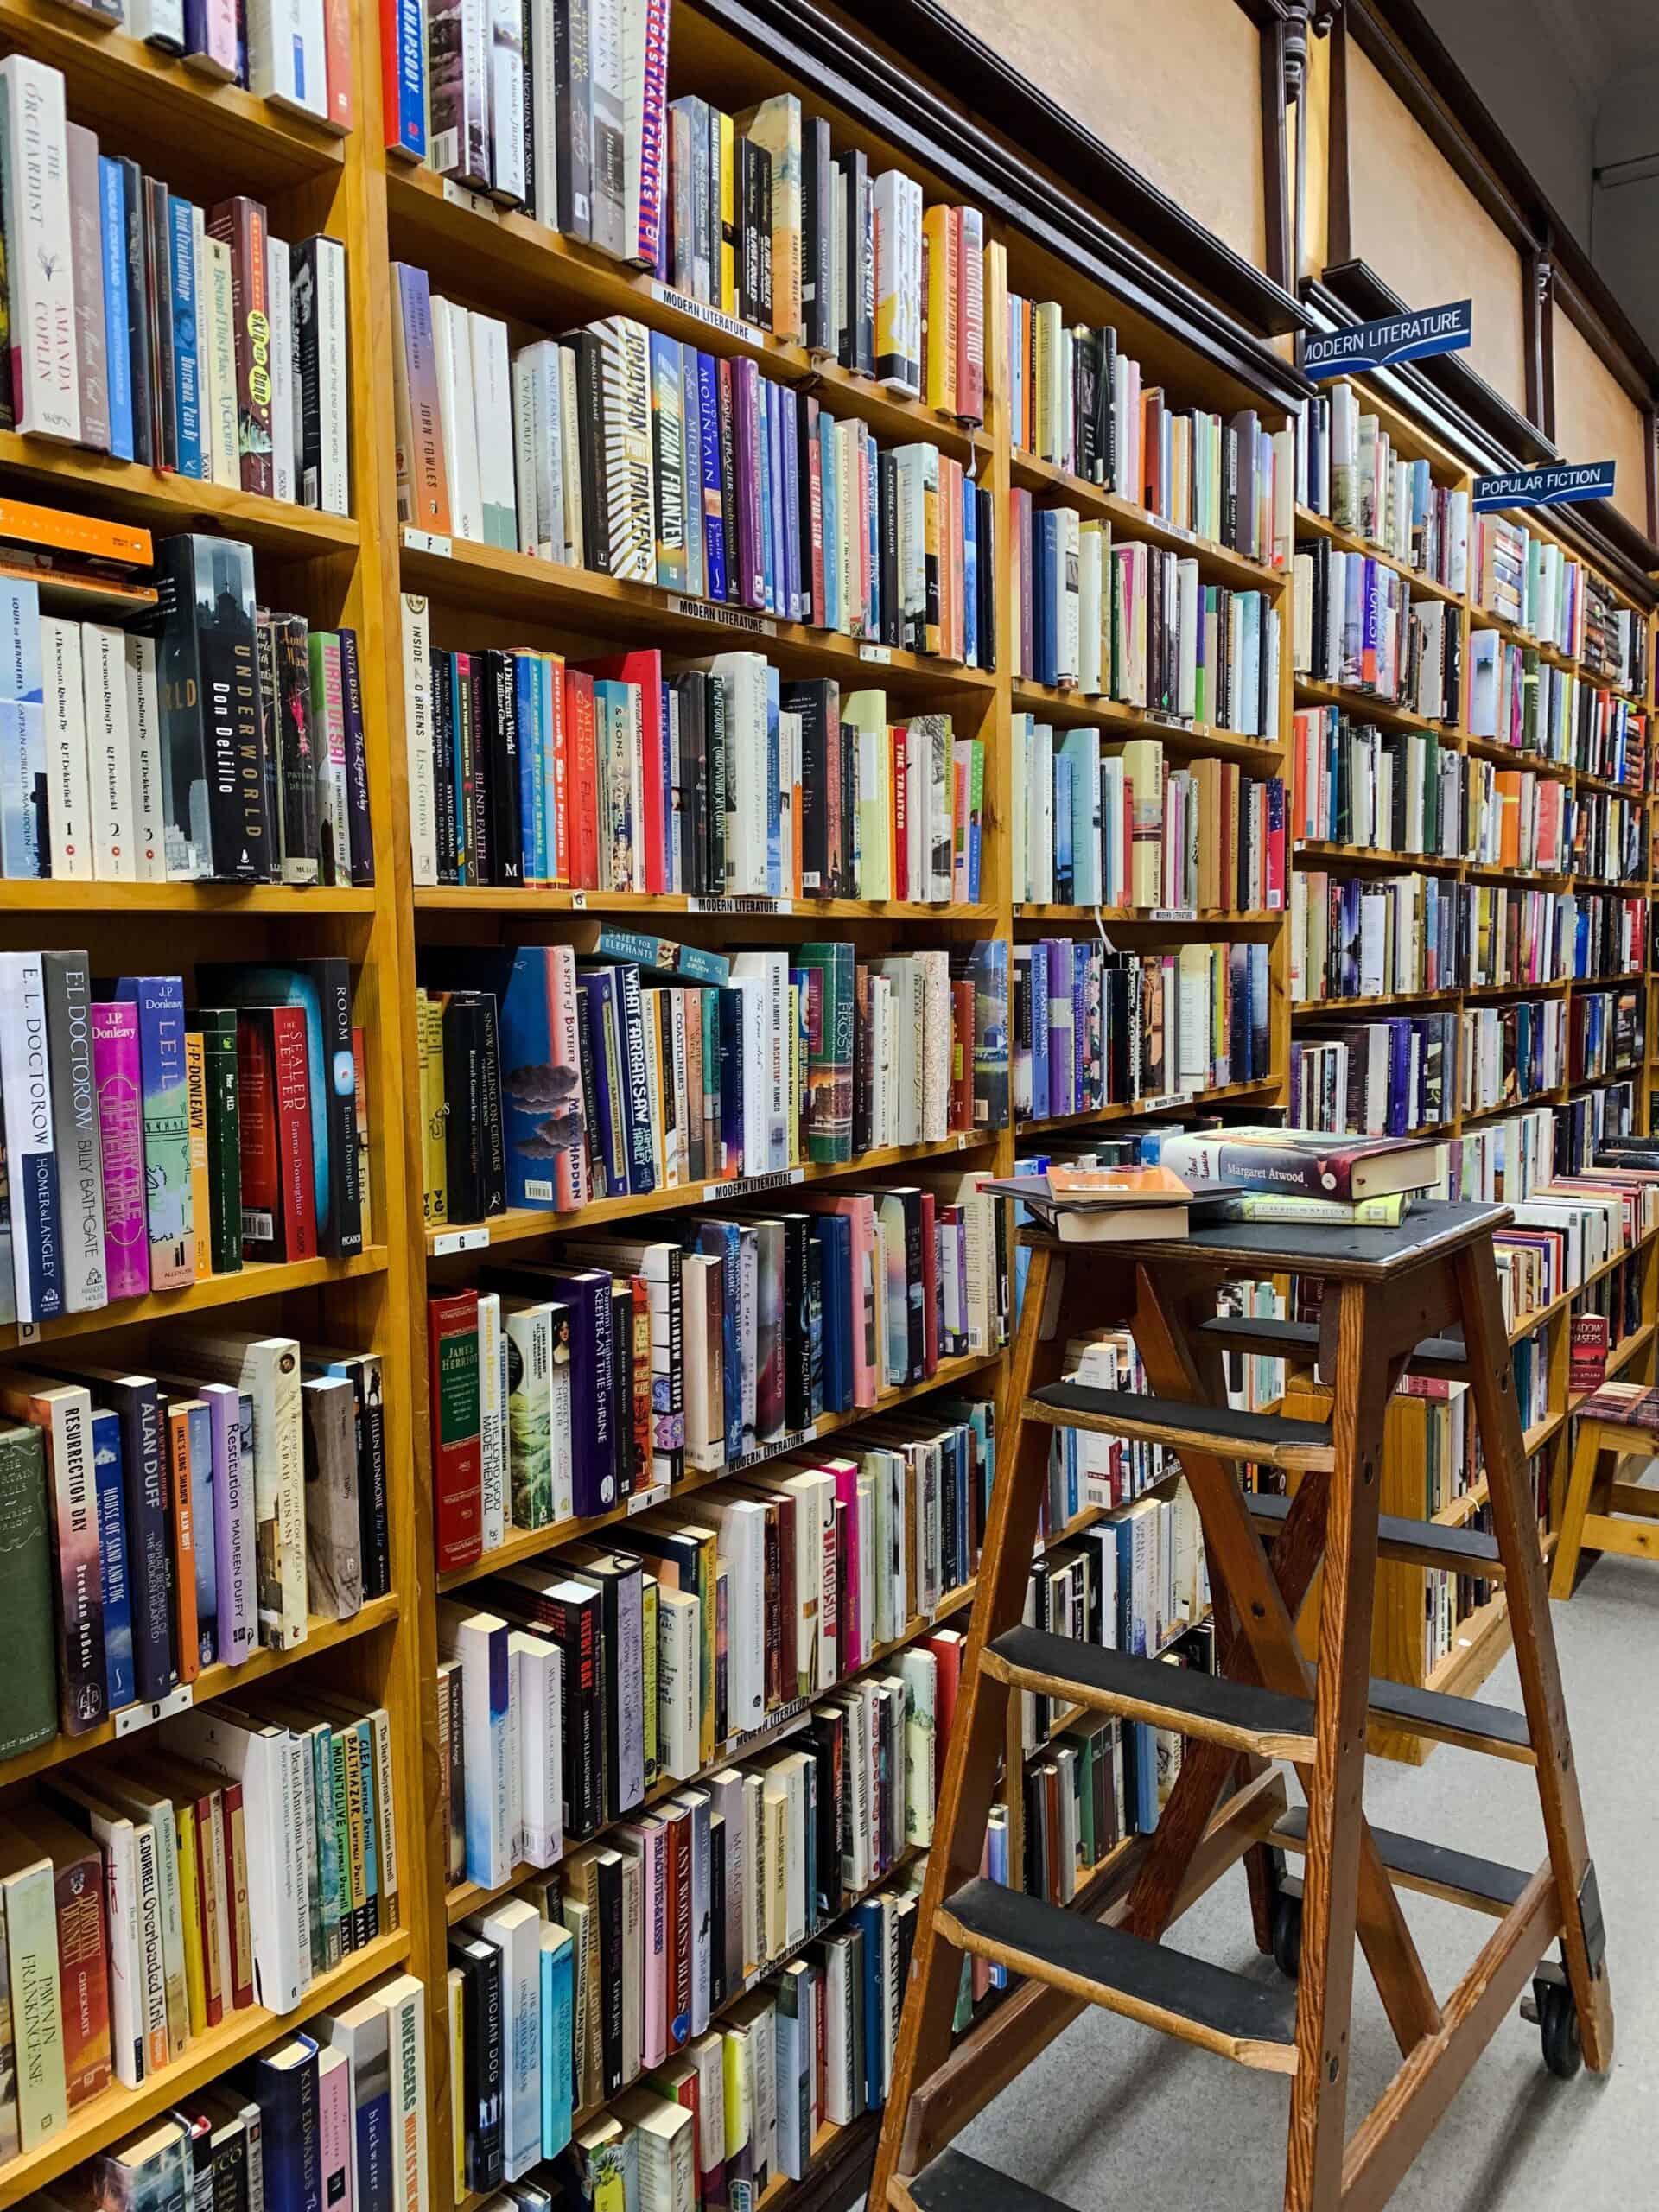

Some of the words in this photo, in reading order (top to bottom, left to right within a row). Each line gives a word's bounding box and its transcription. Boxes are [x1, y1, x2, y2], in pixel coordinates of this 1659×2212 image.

[25, 83, 44, 228] ORCHARDIST
[747, 226, 758, 261] OLIVIA
[747, 263, 759, 302] JOULES
[663, 289, 701, 318] MODERN
[702, 308, 749, 340] LITERATURE
[1370, 309, 1461, 346] LITERATURE
[35, 302, 50, 380] COPLIN
[54, 299, 71, 392] AMANDA
[967, 322, 983, 365] FORD
[625, 331, 646, 436] JONATHAN
[420, 402, 432, 435] JOHN
[659, 376, 681, 464] JONATHAN
[423, 439, 438, 489] FOWLES
[688, 418, 700, 499] MICHAEL
[1482, 476, 1542, 495] POPULAR
[1547, 469, 1601, 487] FICTION
[628, 462, 651, 556] FRANZEN
[660, 473, 682, 549] FRANZEN
[427, 537, 432, 549] F
[680, 601, 715, 620] MODERN
[718, 609, 762, 632] LITERATURE
[413, 626, 423, 662] INSIDE
[503, 655, 512, 664] A
[213, 683, 230, 715] Don
[505, 667, 515, 719] Different
[234, 645, 262, 836] UNDERWORLD
[327, 709, 345, 765] DESAI
[505, 721, 516, 754] World
[584, 698, 594, 766] AMITAV
[216, 728, 233, 793] DeLillo
[416, 749, 426, 779] Lisa
[896, 744, 905, 770] THE
[417, 783, 428, 836] Genova
[474, 772, 486, 816] BLIND
[896, 773, 906, 830] TRAITOR
[476, 819, 486, 860] FAITH
[698, 899, 732, 912] MODERN
[734, 899, 778, 912] LITERATURE
[563, 955, 572, 963] A
[606, 938, 652, 959] ELEPHANTS
[563, 968, 574, 995] SPOT
[626, 969, 641, 1016] WHAT
[145, 999, 182, 1011] Donleavy
[336, 986, 348, 1041] ROOM
[92, 1026, 135, 1040] Donleavy
[483, 1012, 493, 1047] SNOW
[565, 1016, 576, 1063] BOTHER
[836, 1001, 850, 1056] FROST
[26, 1018, 48, 1146] DOCTOROW
[68, 1005, 92, 1130] DOCTOROW
[280, 1033, 295, 1111] LETTER
[291, 1032, 305, 1111] SEALED
[486, 1051, 496, 1100] FALLING
[344, 1106, 353, 1139] Emma
[488, 1103, 498, 1121] ON
[632, 1084, 648, 1122] SAW
[78, 1140, 93, 1173] BILLY
[291, 1121, 302, 1156] Emma
[490, 1123, 500, 1171] CEDARS
[633, 1127, 645, 1165] HANLEY
[644, 1128, 652, 1163] JAMES
[292, 1159, 304, 1216] Donoghue
[345, 1143, 355, 1201] Donoghue
[569, 1143, 582, 1200] HADDON
[715, 1183, 748, 1198] MODERN
[750, 1173, 791, 1192] LITERATURE
[1227, 1162, 1265, 1179] Margaret
[1268, 1168, 1304, 1184] Atwood
[80, 1179, 98, 1258] BATHGATE
[105, 1175, 124, 1225] YORK
[459, 1236, 465, 1248] G
[594, 1288, 605, 1337] KEEPER
[671, 1281, 681, 1302] THE
[22, 1325, 34, 1337] D
[448, 1344, 474, 1359] JAMES
[594, 1339, 605, 1357] AT
[671, 1308, 681, 1360] RAINBOW
[596, 1363, 605, 1389] THE
[672, 1367, 682, 1409] TROOPS
[141, 1402, 157, 1454] ALAN
[482, 1415, 493, 1452] MADE
[596, 1393, 607, 1444] SHRINE
[65, 1408, 86, 1504] RESURRECTION
[227, 1423, 239, 1510] Restitution
[282, 1434, 291, 1481] SARAH
[483, 1455, 493, 1490] THEM
[728, 1449, 761, 1472] MODERN
[762, 1433, 804, 1459] LITERATURE
[104, 1487, 120, 1521] HOUSE
[143, 1460, 159, 1509] DUFF
[484, 1491, 493, 1515] ALL
[71, 1510, 87, 1534] DAY
[105, 1522, 121, 1535] OF
[283, 1489, 293, 1548] DUNANT
[105, 1537, 122, 1563] SAND
[231, 1519, 242, 1576] MAUREEN
[76, 1564, 89, 1618] Brendan
[108, 1566, 123, 1582] AND
[109, 1584, 124, 1603] FOG
[823, 1547, 836, 1625] JACOBSON
[233, 1580, 244, 1618] DUFFY
[79, 1624, 92, 1669] DuBois
[152, 1703, 160, 1718] D
[291, 1751, 302, 1774] Best
[292, 1777, 302, 1788] of
[346, 1737, 360, 1816] BALTHAZAR
[333, 1746, 347, 1827] MOUNTOLIVE
[293, 1789, 304, 1845] Antrobus
[336, 1833, 345, 1872] Lawrence
[351, 1821, 360, 1861] Lawrence
[677, 1846, 689, 1878] ANY
[296, 1847, 306, 1904] Lawrence
[338, 1876, 347, 1910] Durrell
[353, 1865, 363, 1897] Durrell
[62, 1897, 82, 1968] DUNNETT
[79, 1891, 101, 1956] DOROTHY
[297, 1904, 308, 1948] Durrell
[355, 1910, 365, 1949] FABER
[143, 1897, 162, 1995] Overloaded
[40, 1976, 55, 2022] PAWN
[78, 1972, 90, 2037] CHECKMATE
[677, 1962, 689, 2013] BLUES
[20, 1955, 43, 2088] FRANKINCENSE
[44, 2026, 56, 2044] IN
[149, 1997, 163, 2030] Ark
[401, 2004, 416, 2042] DAVE
[488, 1983, 499, 2044] TROJAN
[301, 2069, 311, 2103] KIM
[402, 2043, 416, 2112] EGGERS
[488, 2050, 499, 2082] DOG
[302, 2108, 314, 2190] EDWARDS
[367, 2109, 380, 2190] blackwater
